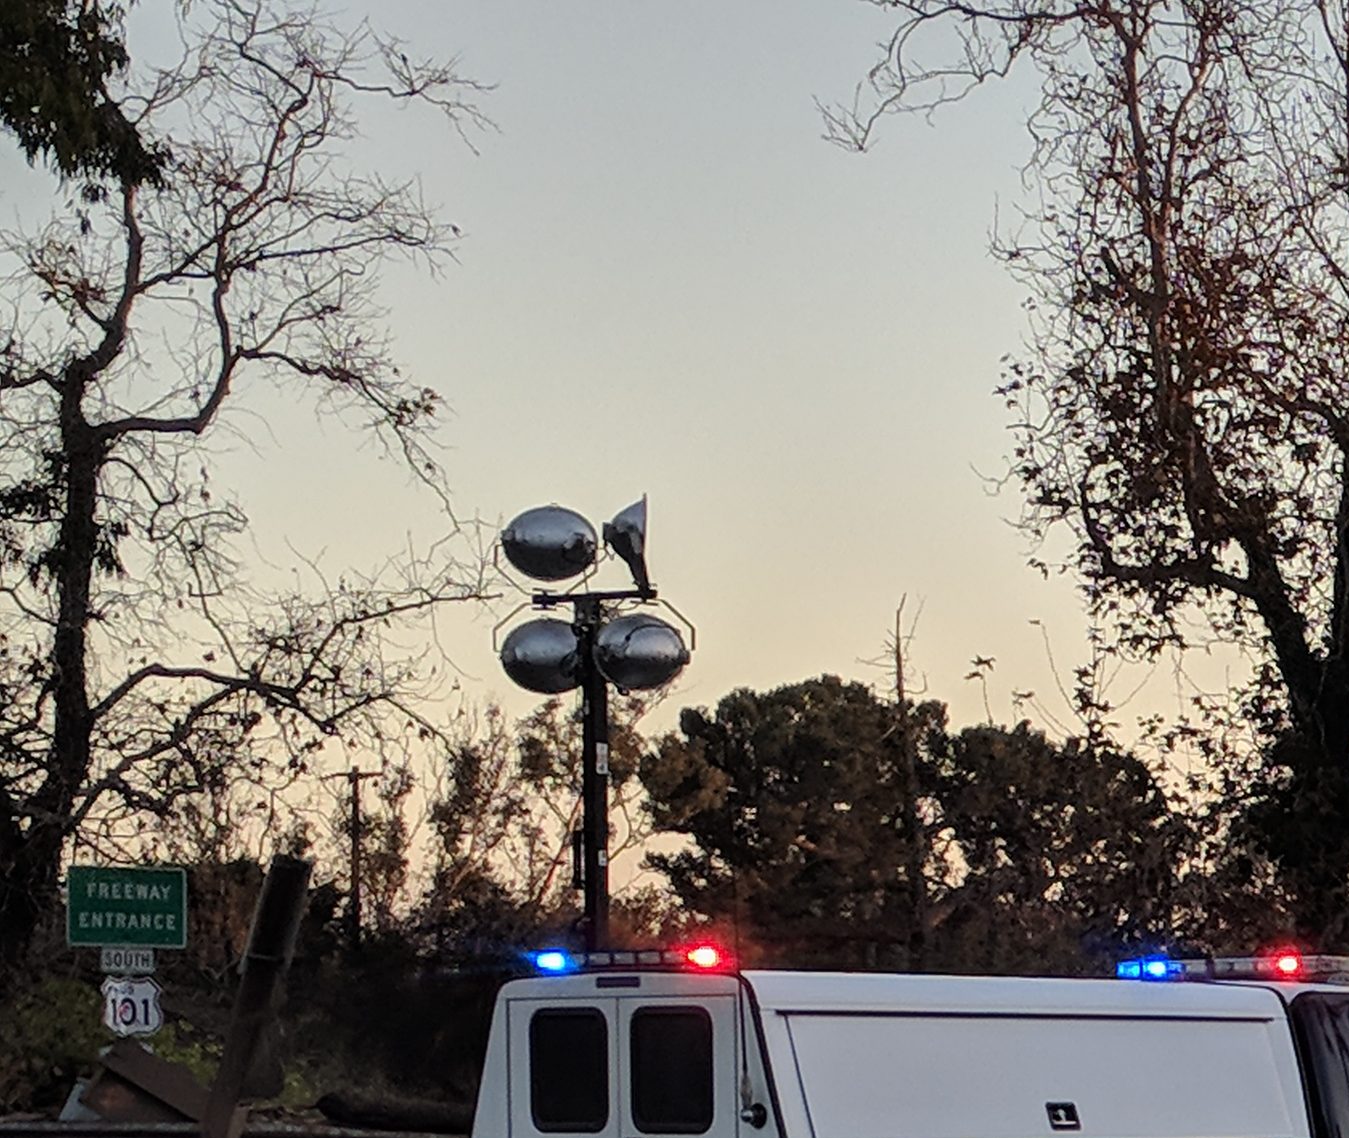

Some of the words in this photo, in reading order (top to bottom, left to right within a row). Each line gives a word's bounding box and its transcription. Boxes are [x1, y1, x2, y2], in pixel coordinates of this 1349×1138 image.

[86, 882, 172, 900] FREEWAY
[78, 911, 177, 930] ENTRANCE
[104, 951, 151, 968] SOUTH
[111, 997, 150, 1026] 101
